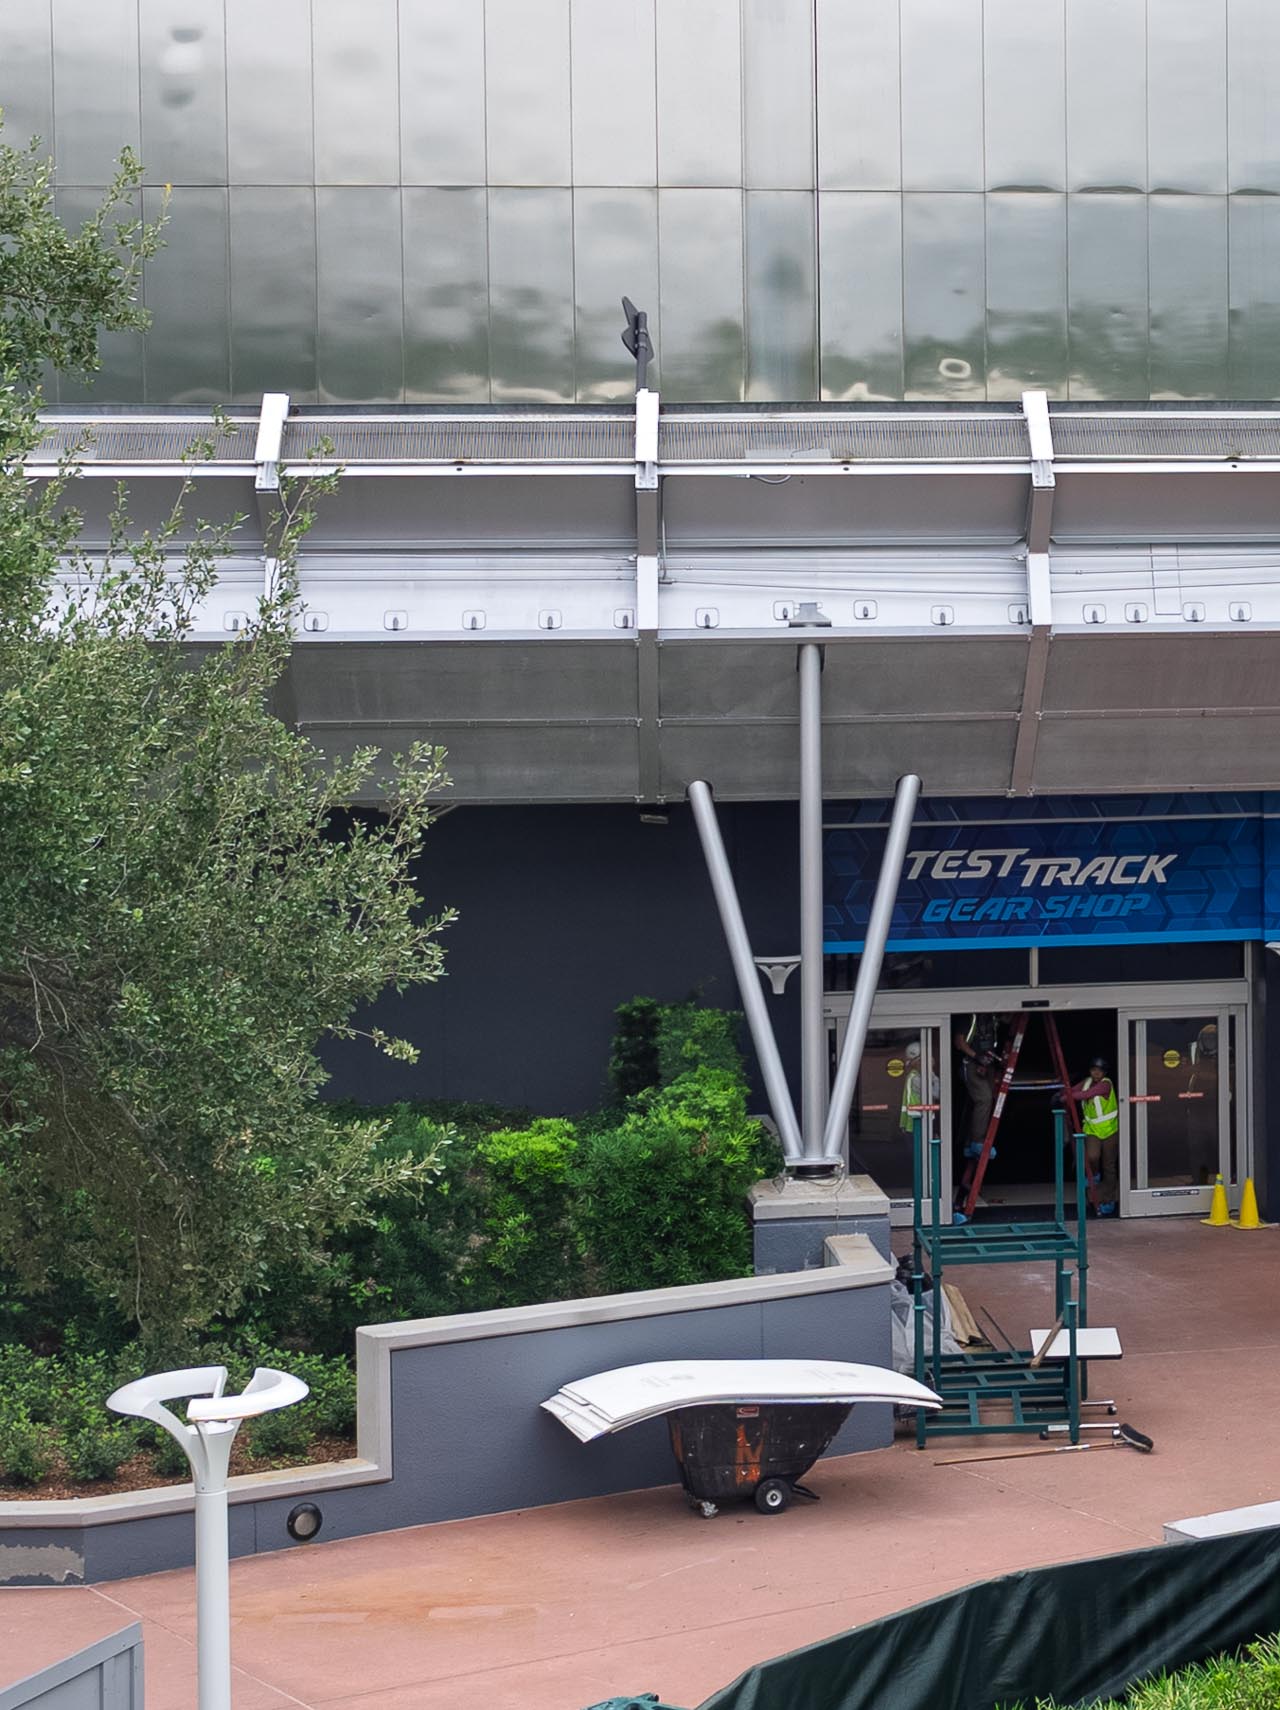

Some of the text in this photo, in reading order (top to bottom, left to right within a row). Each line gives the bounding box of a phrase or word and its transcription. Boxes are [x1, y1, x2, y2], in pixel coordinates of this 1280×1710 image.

[906, 848, 1178, 887] TEST TRACK
[922, 893, 1151, 922] GEAR SHOP
